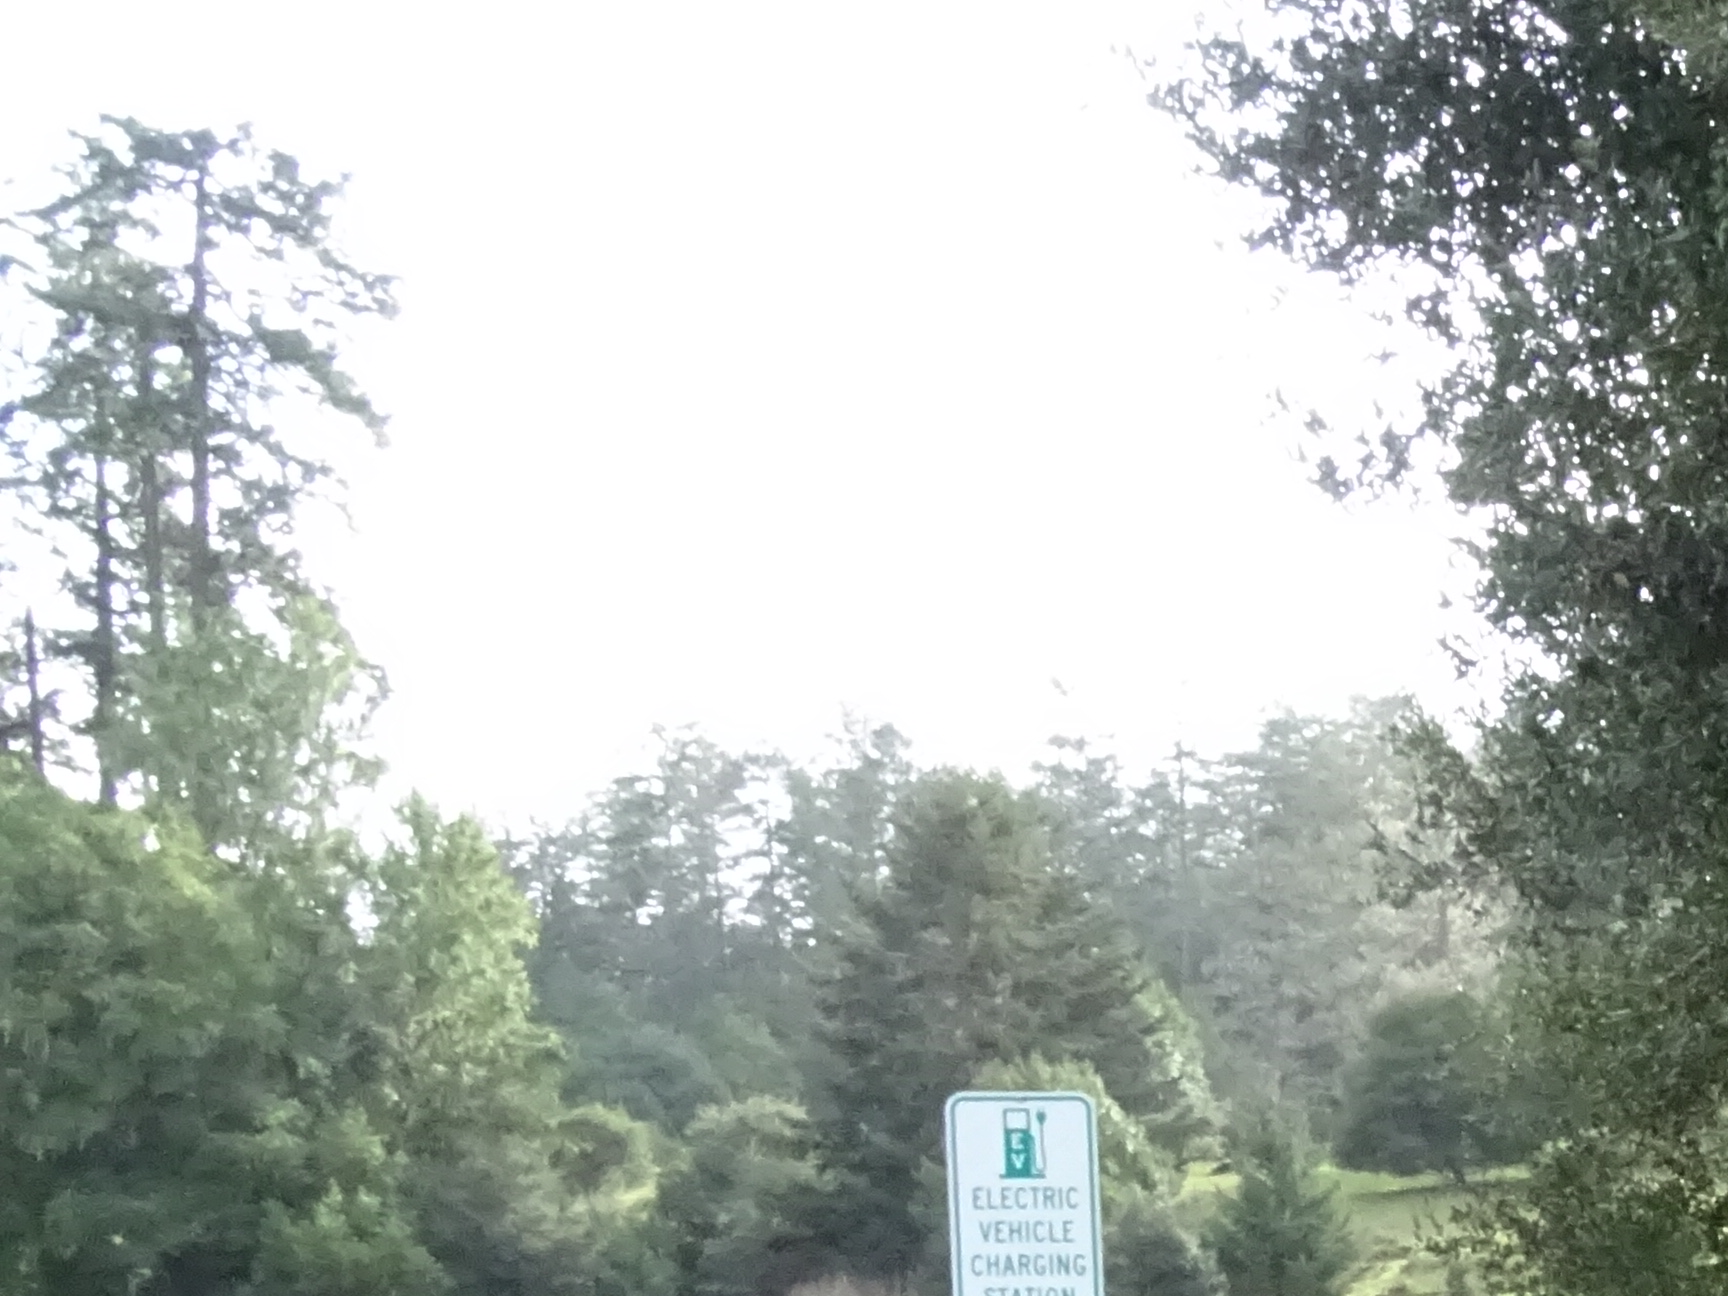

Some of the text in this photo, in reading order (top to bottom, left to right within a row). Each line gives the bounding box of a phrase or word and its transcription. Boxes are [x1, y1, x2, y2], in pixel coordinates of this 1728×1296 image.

[972, 1187, 1079, 1210] ELECTRIC
[979, 1220, 1074, 1243] VEHICLE
[971, 1254, 1087, 1277] CHARGING
